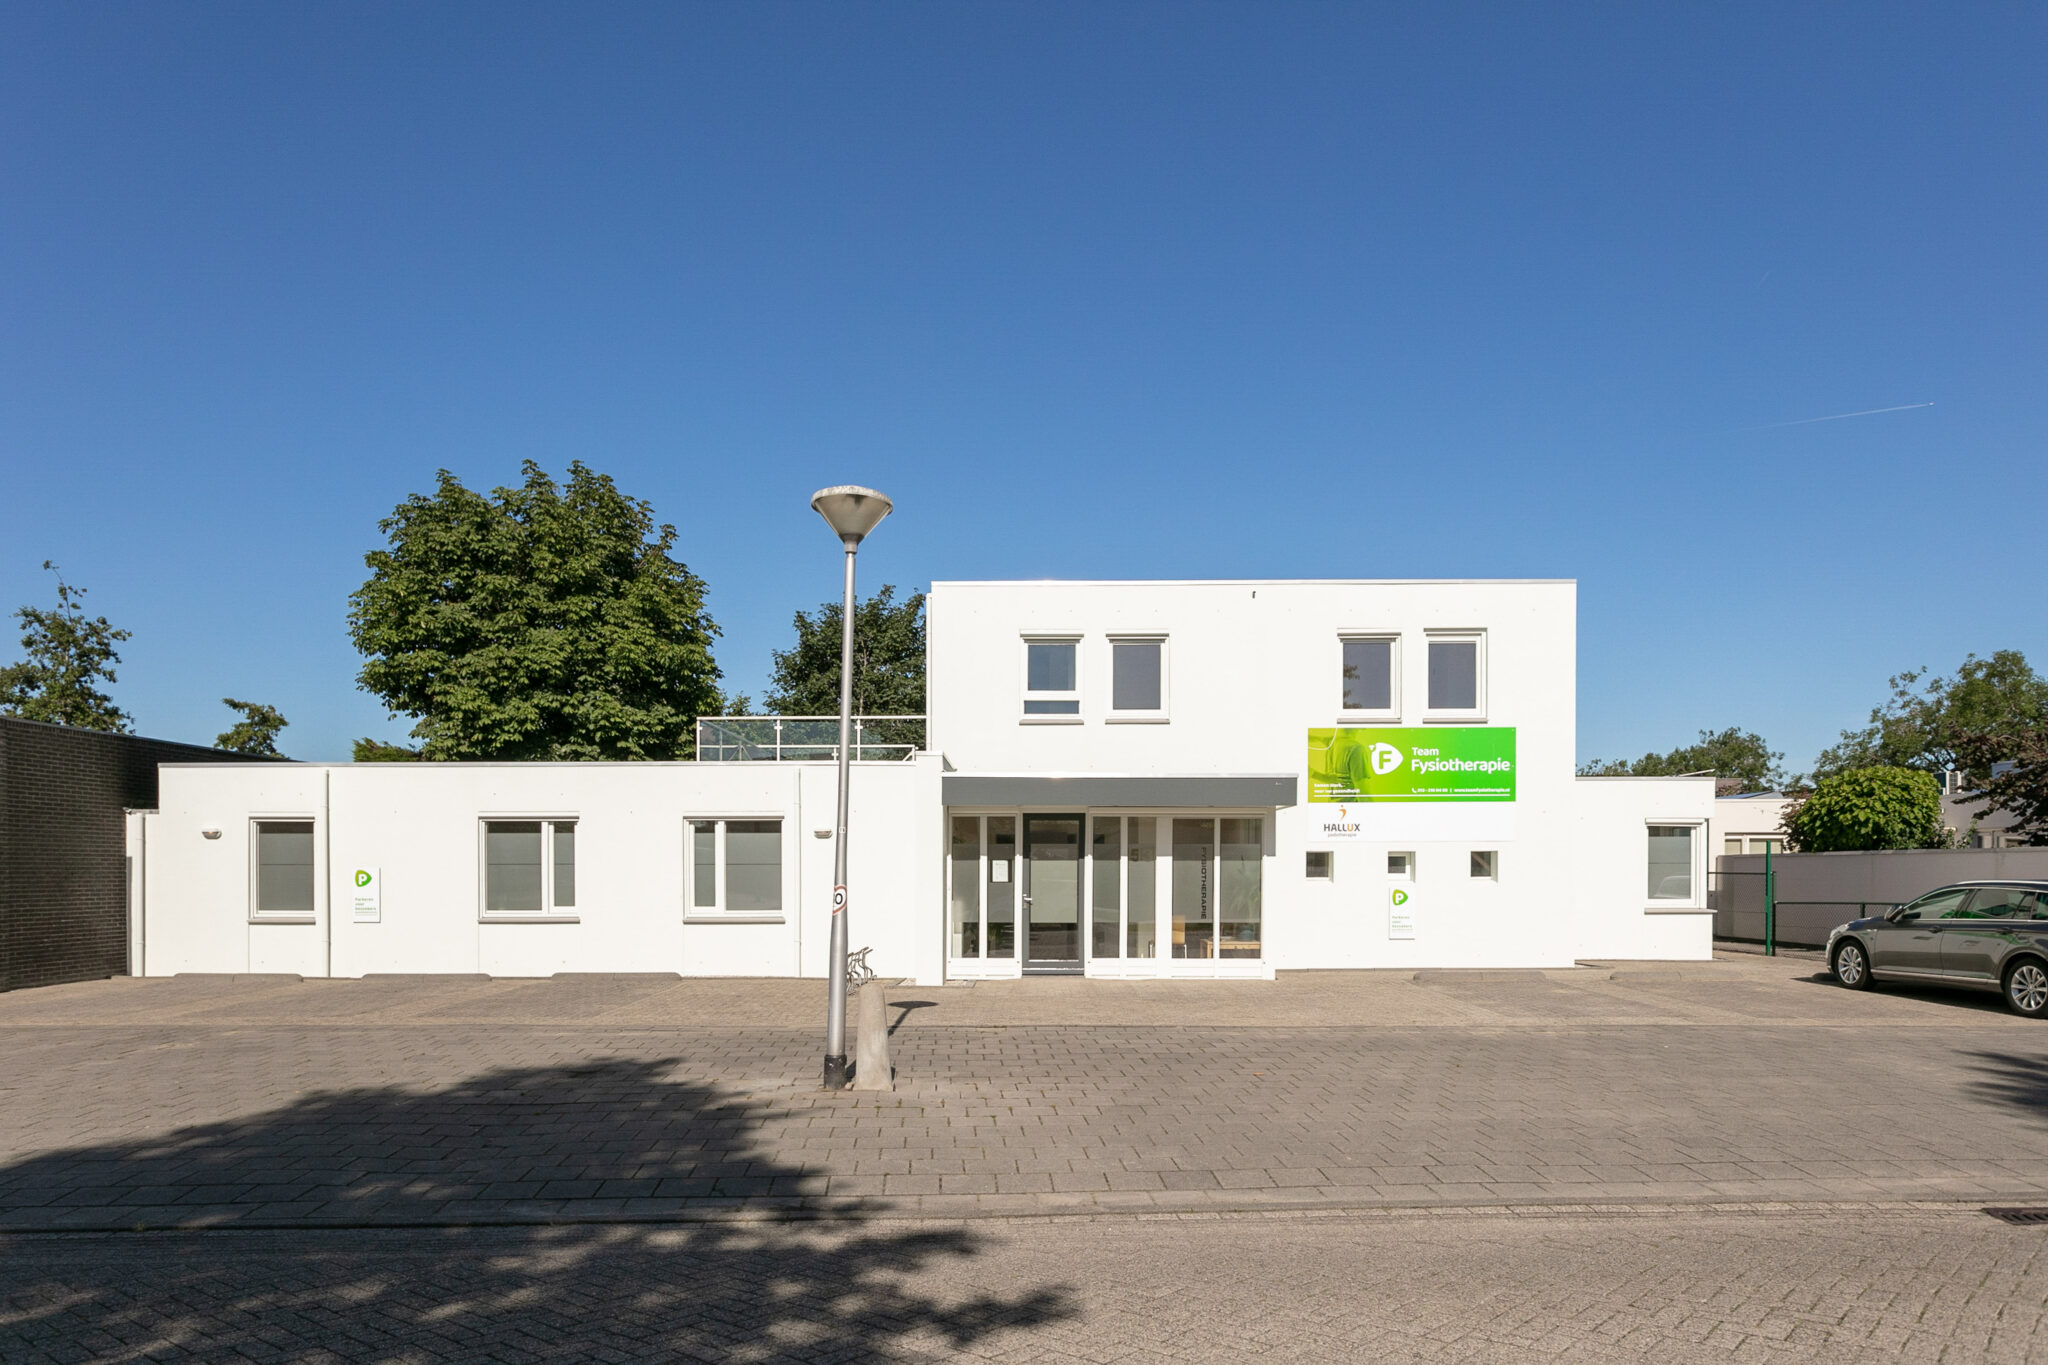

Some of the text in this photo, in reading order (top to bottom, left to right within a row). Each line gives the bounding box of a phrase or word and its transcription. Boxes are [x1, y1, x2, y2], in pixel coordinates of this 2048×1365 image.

[1412, 747, 1439, 756] Team
[1411, 758, 1510, 774] Fysiotherapie
[1323, 823, 1360, 832] HALLUX
